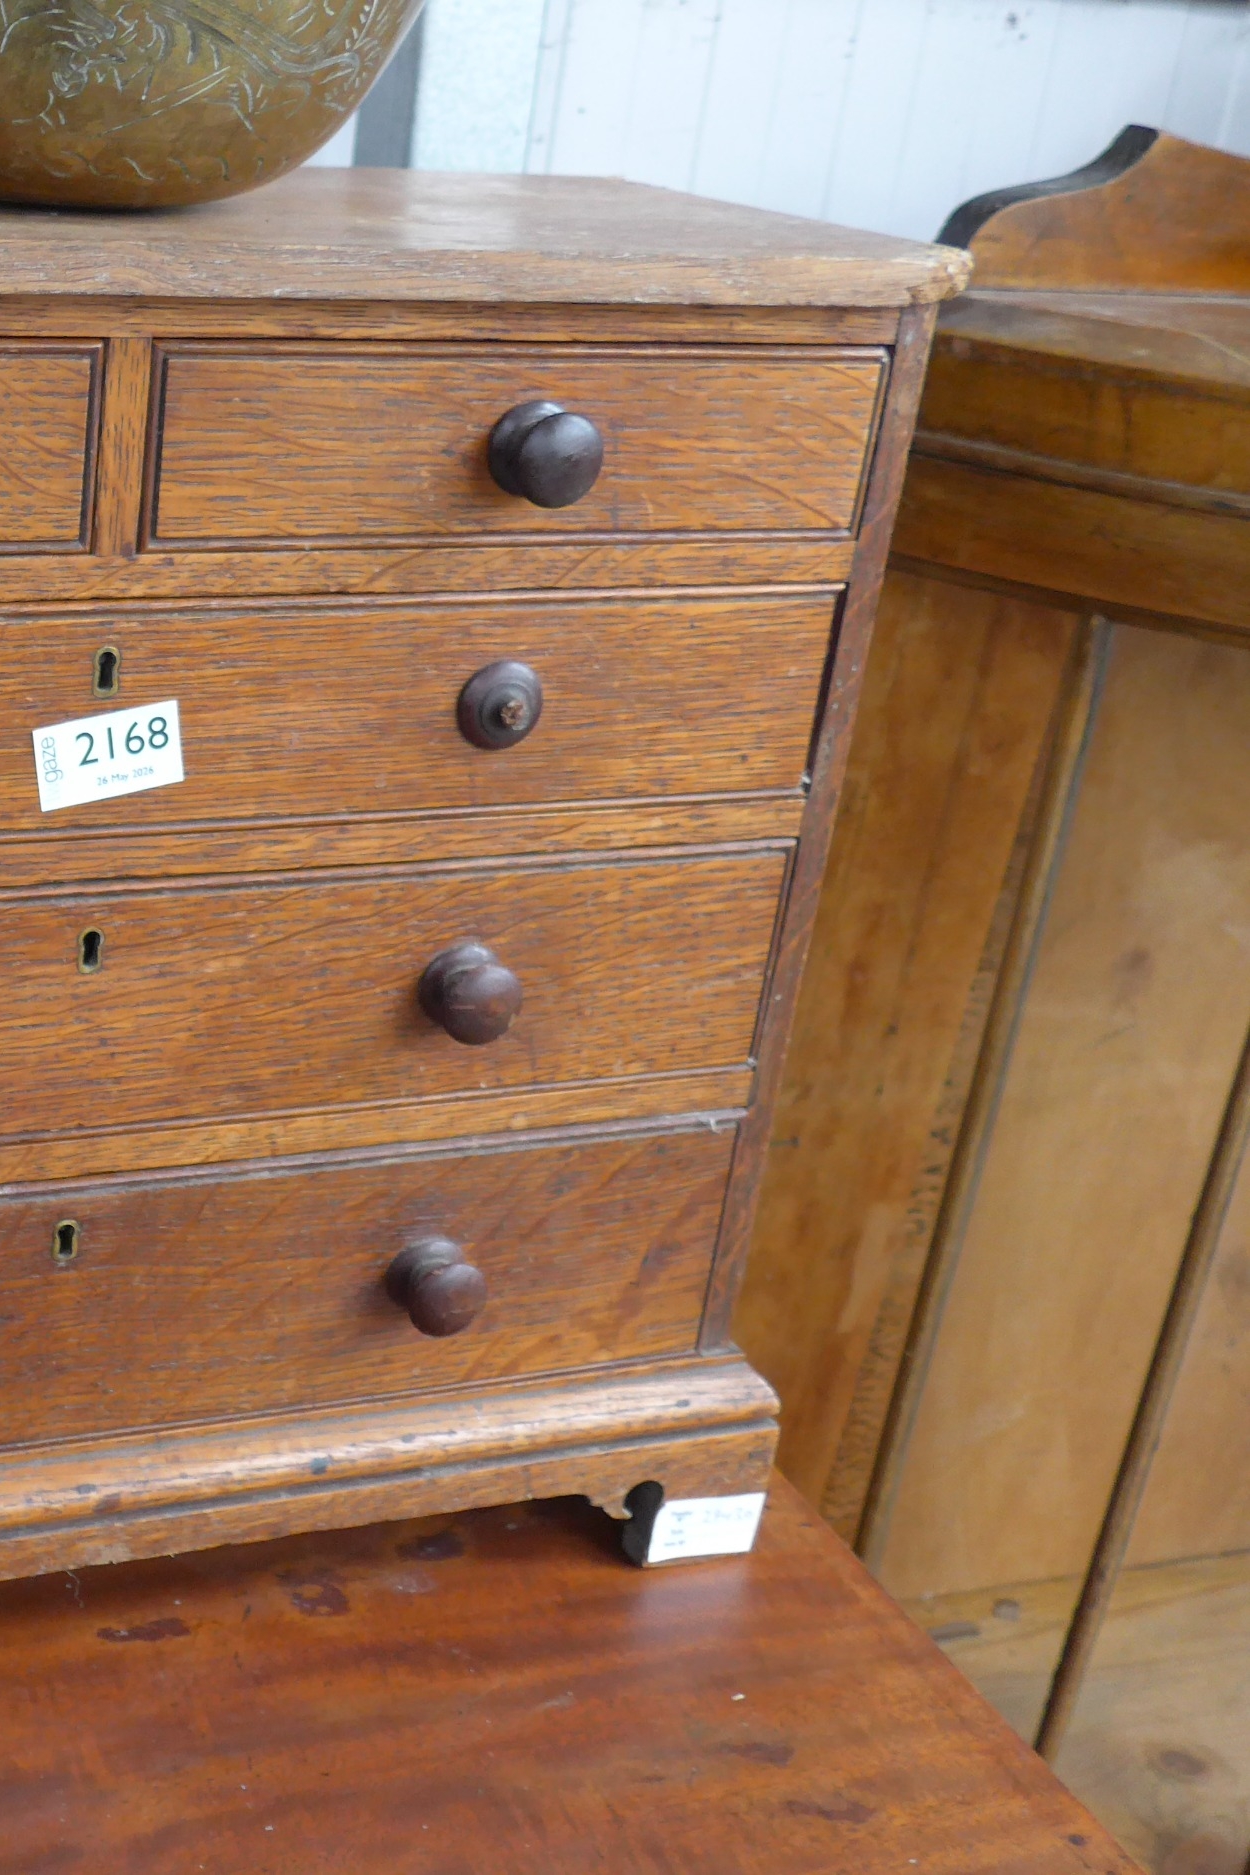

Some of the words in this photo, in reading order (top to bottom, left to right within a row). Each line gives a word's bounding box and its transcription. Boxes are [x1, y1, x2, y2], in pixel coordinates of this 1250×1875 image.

[41, 736, 63, 783] gaze
[76, 716, 169, 766] 2168
[111, 773, 129, 783] May
